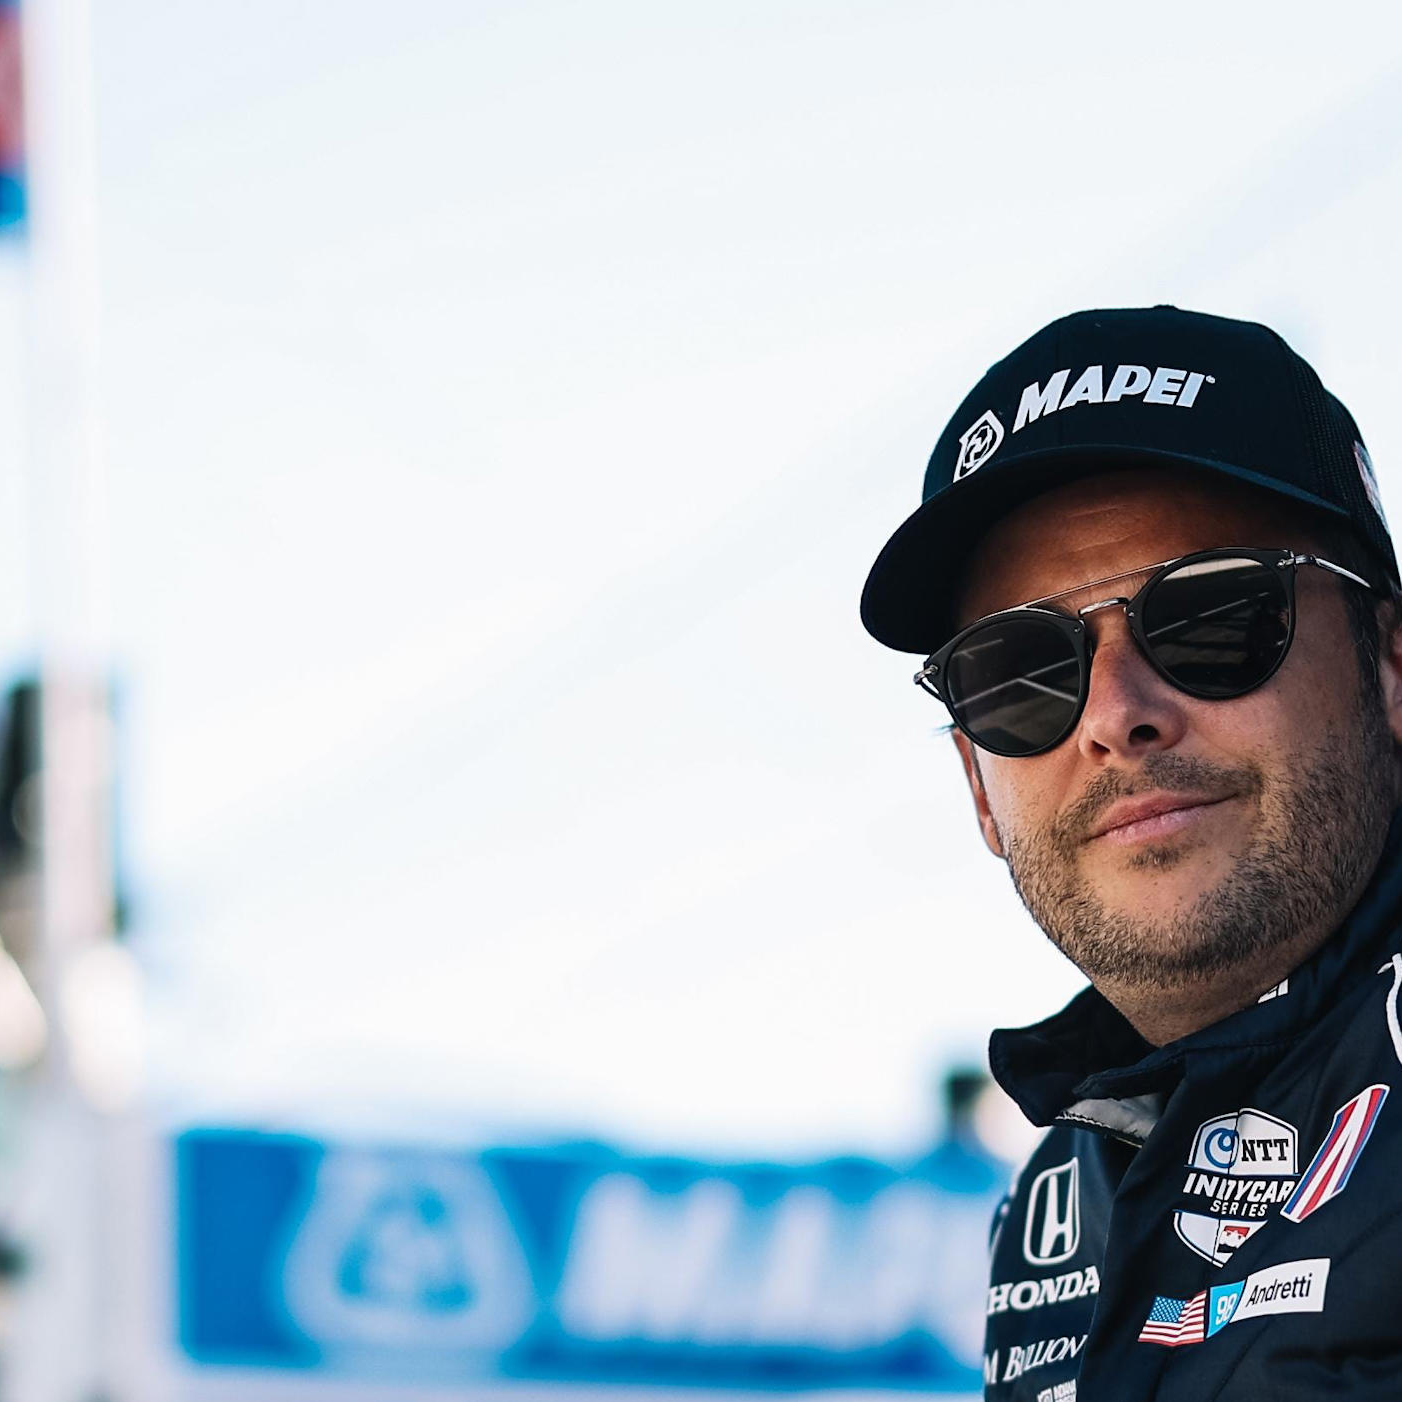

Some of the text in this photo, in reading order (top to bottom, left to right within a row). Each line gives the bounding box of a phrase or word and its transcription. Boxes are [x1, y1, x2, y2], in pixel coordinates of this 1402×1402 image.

[1011, 364, 1206, 434] MAPEI
[1241, 1138, 1290, 1162] NTT
[1209, 1199, 1269, 1218] SERIES
[986, 1264, 1102, 1316] HONDA
[1245, 1272, 1313, 1309] Andretti
